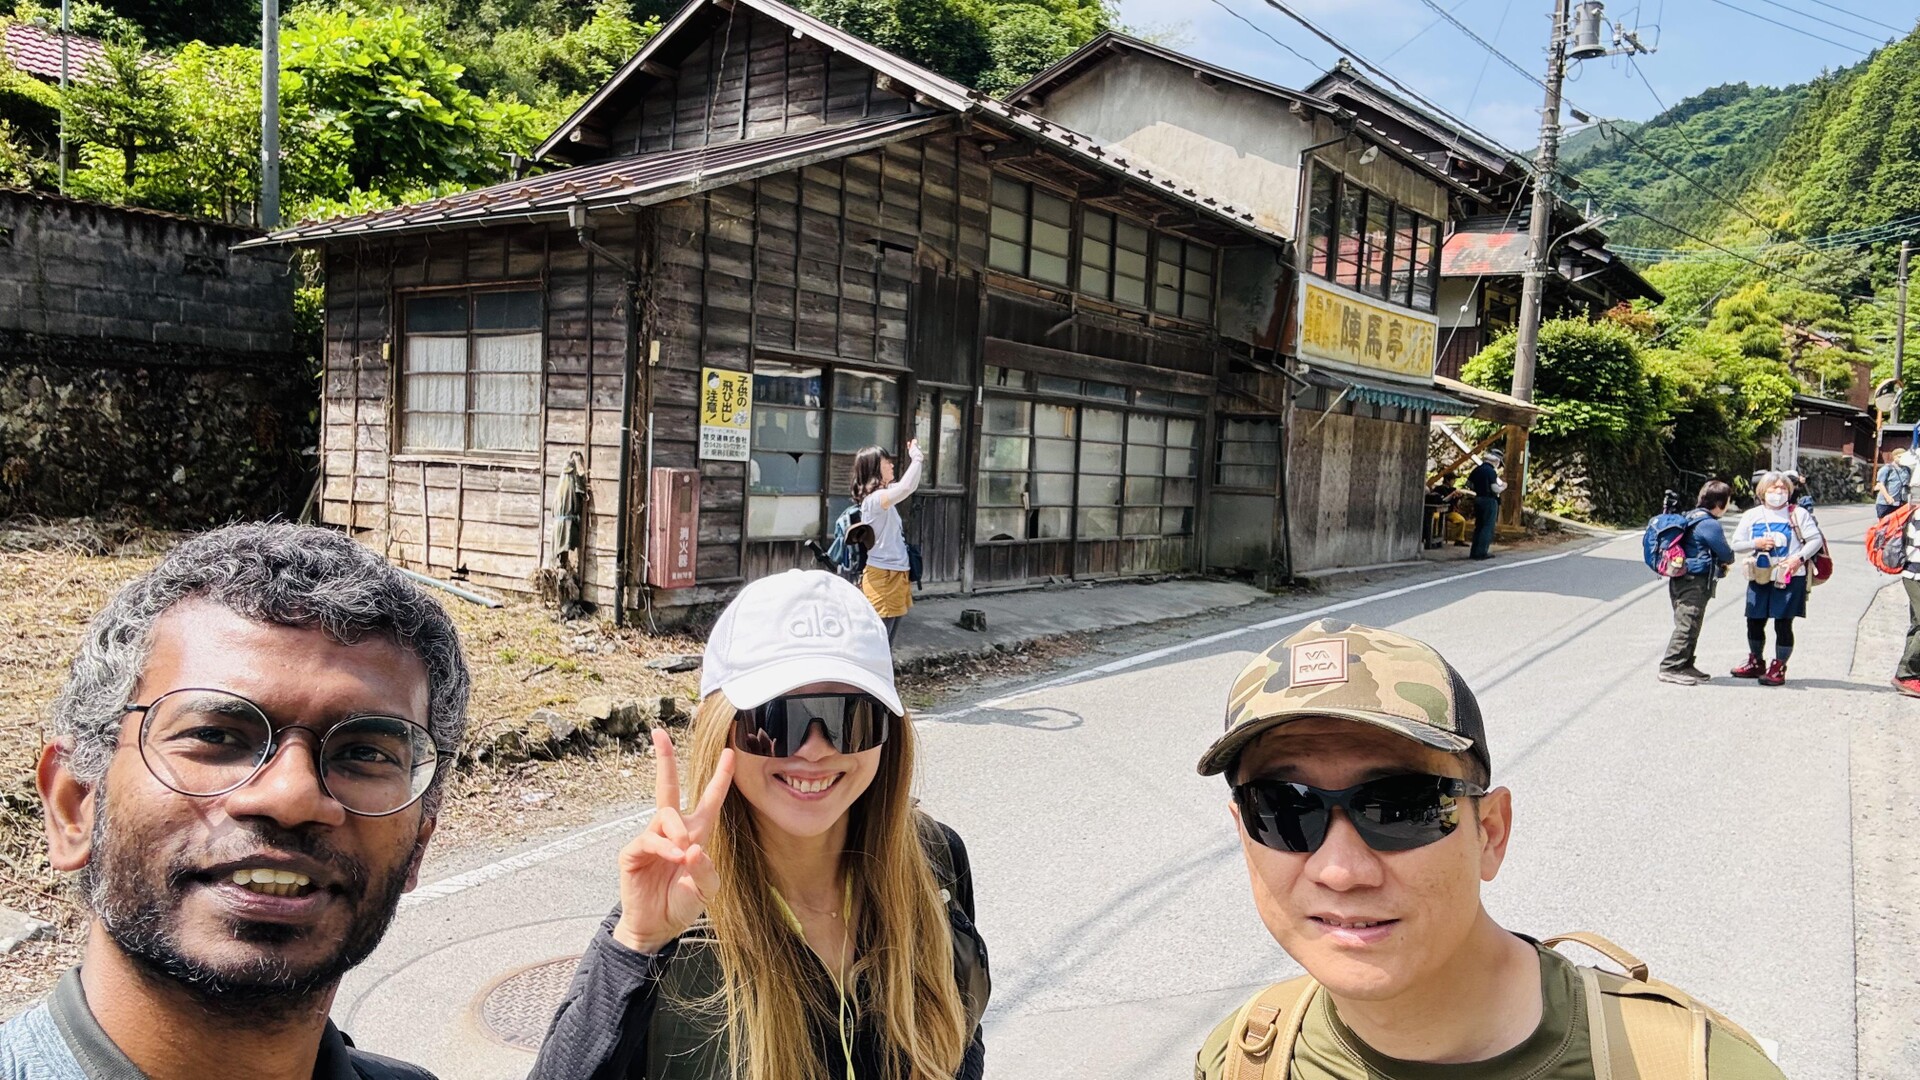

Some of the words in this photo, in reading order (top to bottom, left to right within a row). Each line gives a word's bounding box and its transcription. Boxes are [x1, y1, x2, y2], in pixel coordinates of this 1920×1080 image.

[1340, 305, 1403, 363] 陣馬亭
[721, 380, 733, 423] 飛び出し
[737, 375, 748, 407] 子供の
[789, 603, 845, 638] alo
[1299, 661, 1338, 673] RVCA
